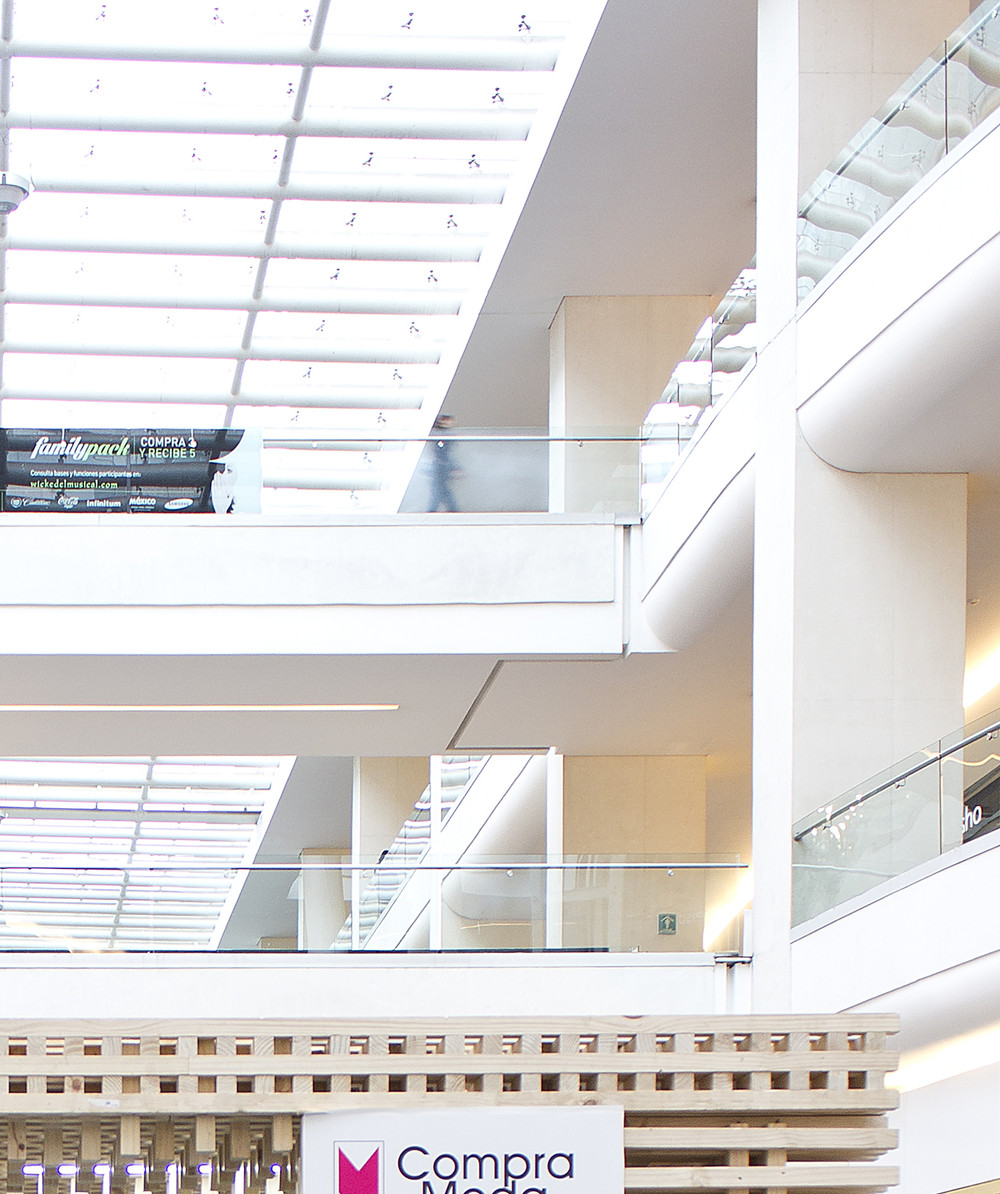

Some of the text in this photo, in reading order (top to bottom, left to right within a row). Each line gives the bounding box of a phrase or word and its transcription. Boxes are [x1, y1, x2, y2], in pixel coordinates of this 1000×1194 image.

[140, 437, 186, 447] COMPRA
[139, 448, 196, 458] Y RECIBE 5
[30, 479, 118, 489] wickedelmusical.com
[397, 1146, 575, 1187] Compra
